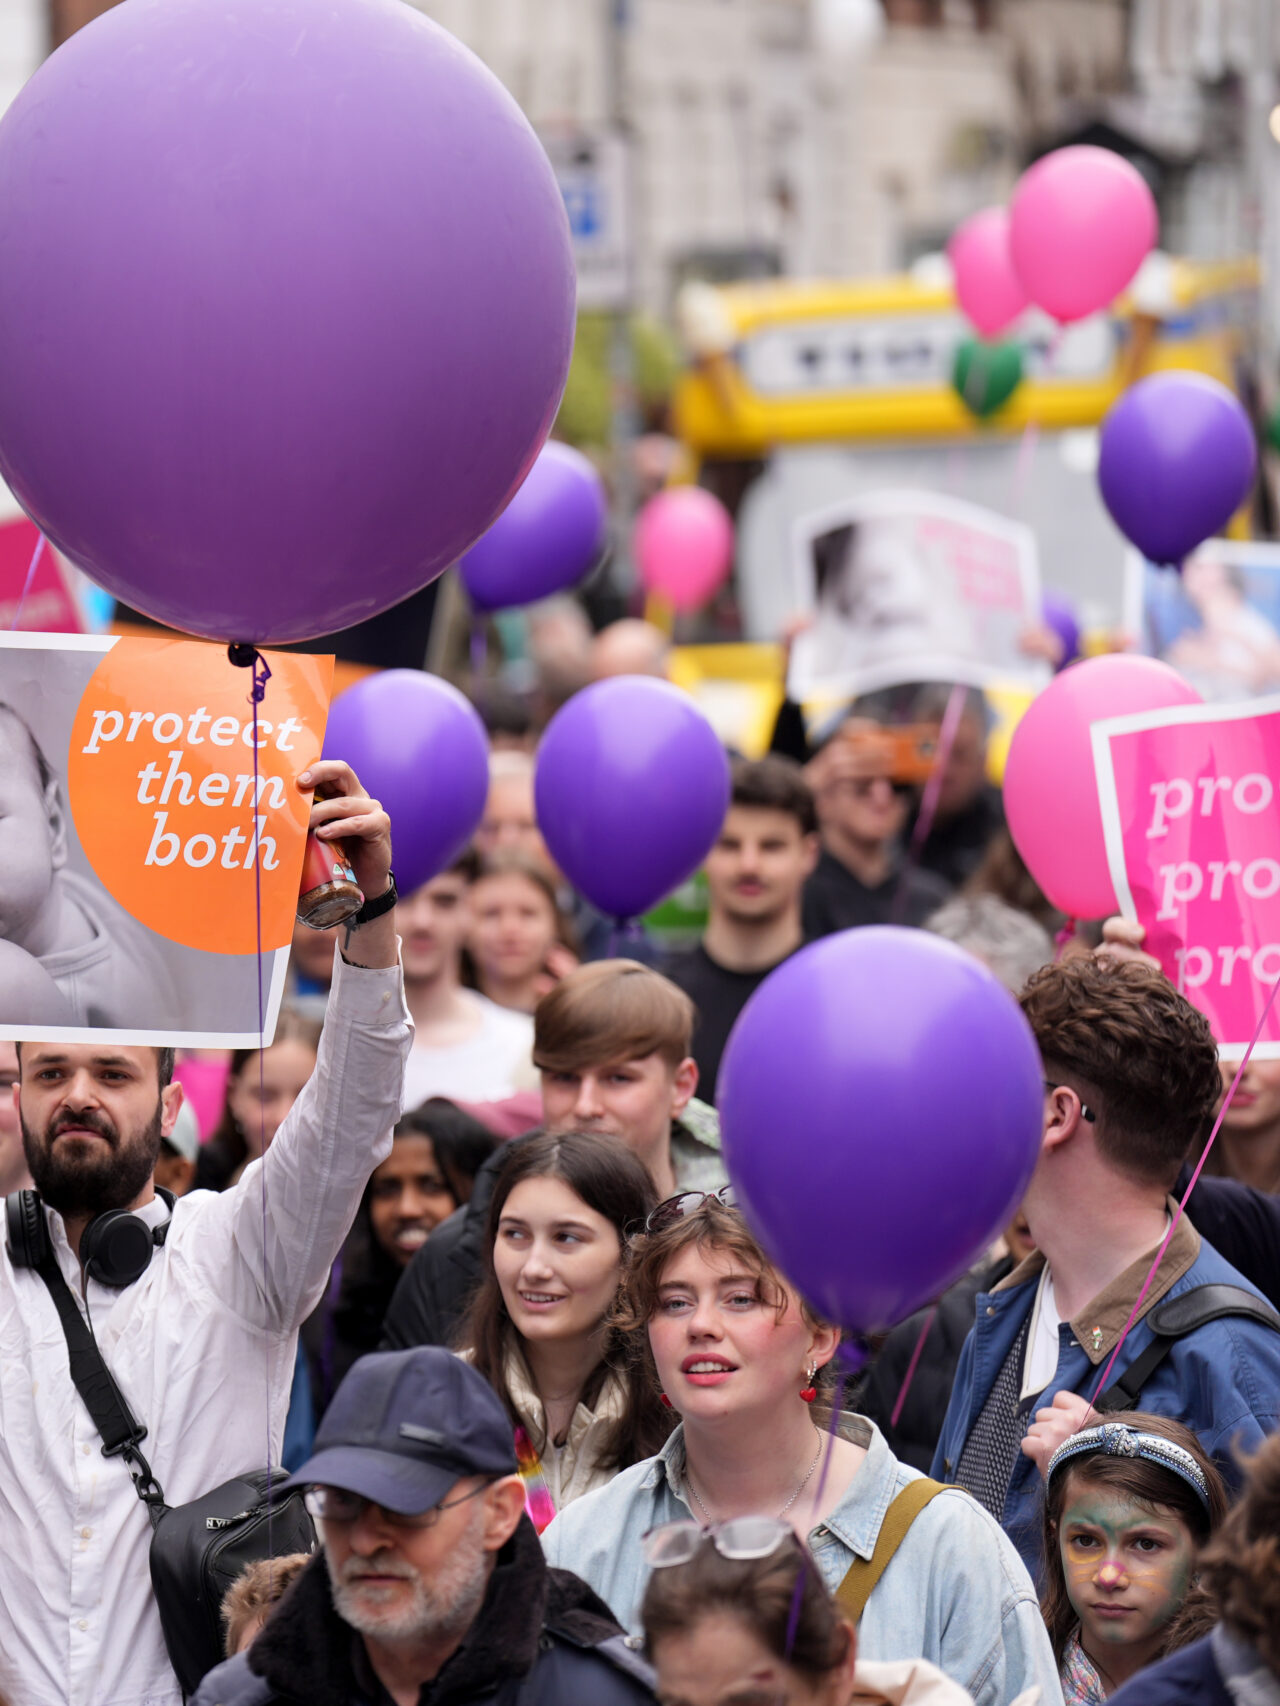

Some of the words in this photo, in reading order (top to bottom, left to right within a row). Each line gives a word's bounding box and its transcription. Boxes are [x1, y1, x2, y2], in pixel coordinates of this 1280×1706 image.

[82, 706, 302, 753] protect
[137, 750, 286, 809] them
[1146, 773, 1273, 839] pro
[144, 811, 280, 870] both
[1156, 857, 1280, 921] pro
